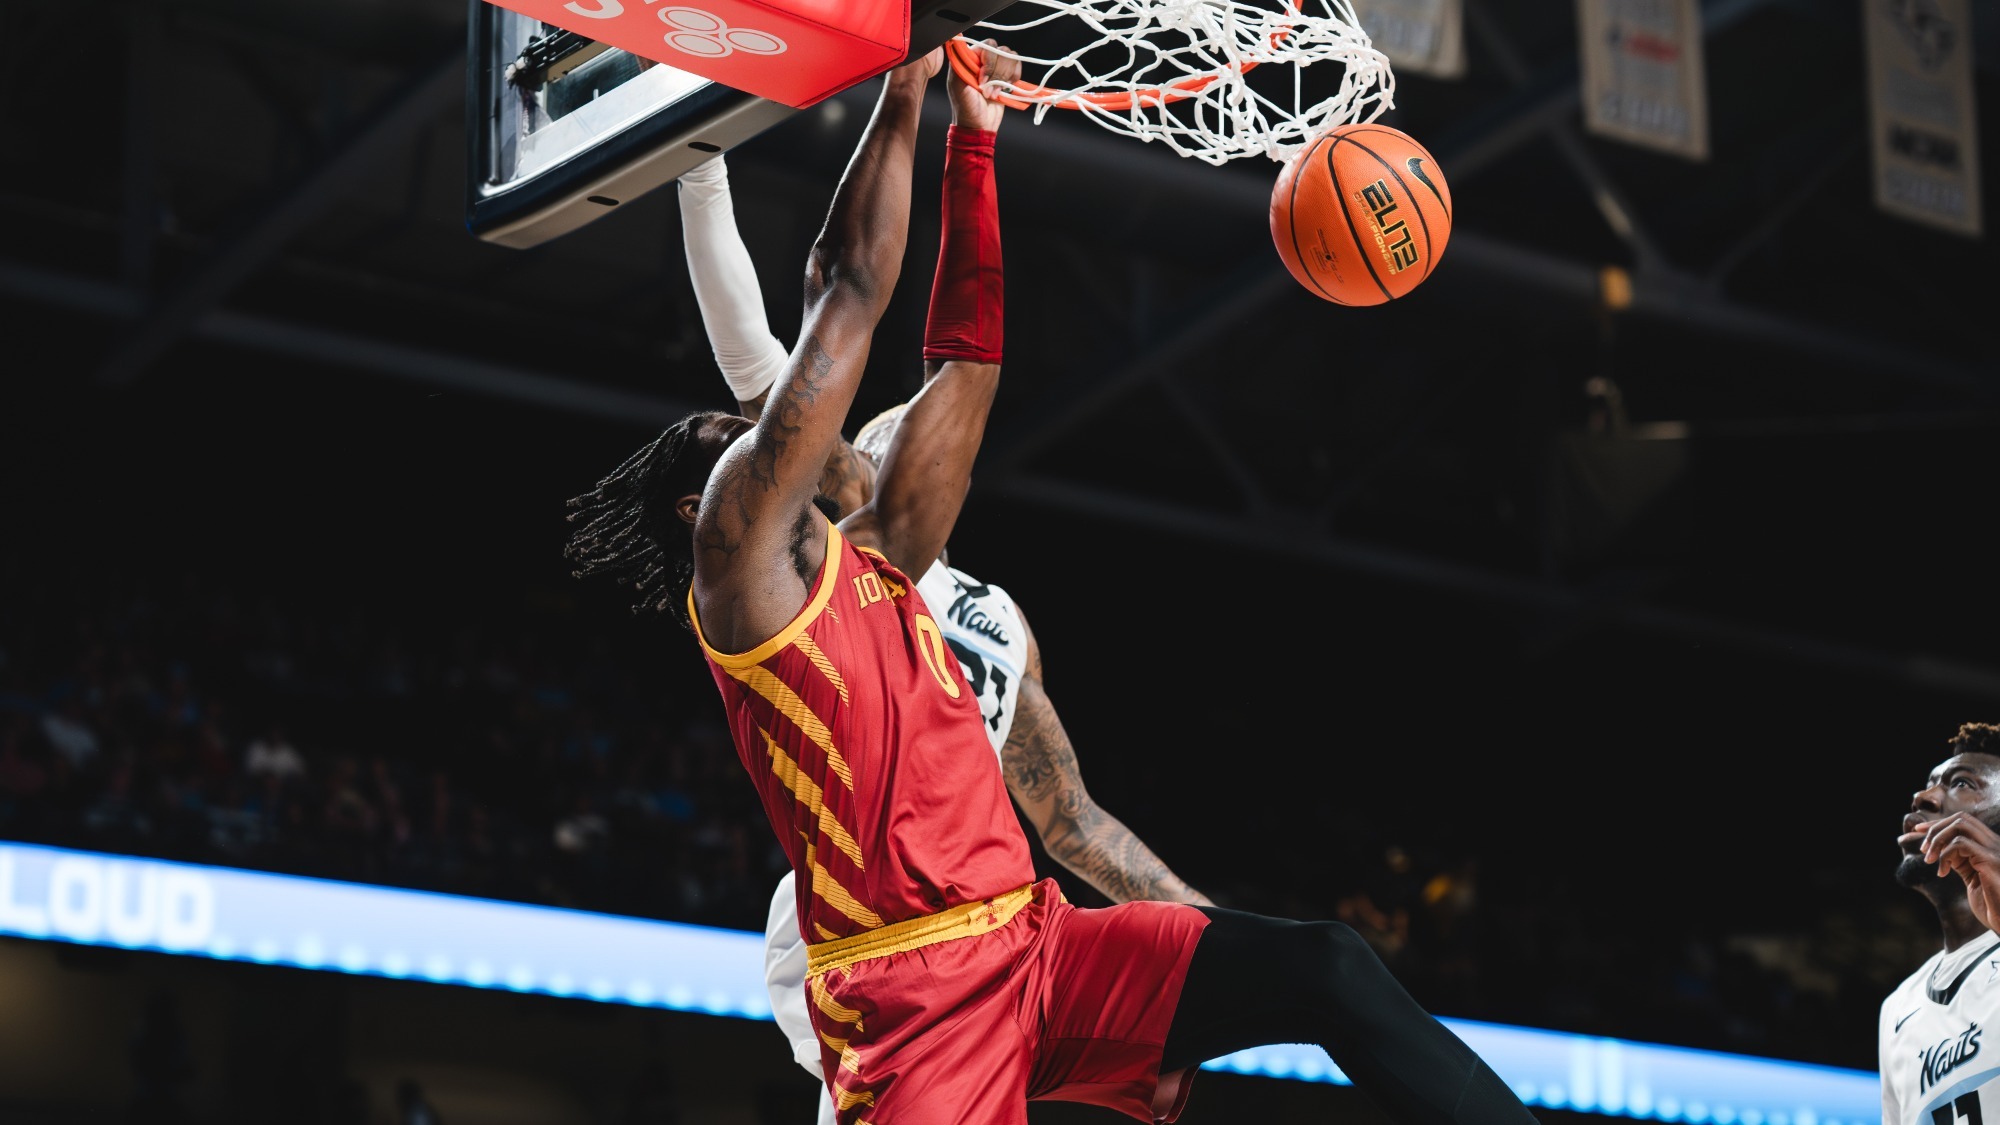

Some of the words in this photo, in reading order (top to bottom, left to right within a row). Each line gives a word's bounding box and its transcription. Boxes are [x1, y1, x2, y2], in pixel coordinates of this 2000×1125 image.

[1353, 191, 1397, 276] CHAMPIONSHIP
[1360, 178, 1420, 273] ELITE
[852, 571, 907, 610] IOA
[915, 612, 961, 699] 0
[0, 850, 214, 950] LOUD
[1919, 1021, 1983, 1097] Nauts
